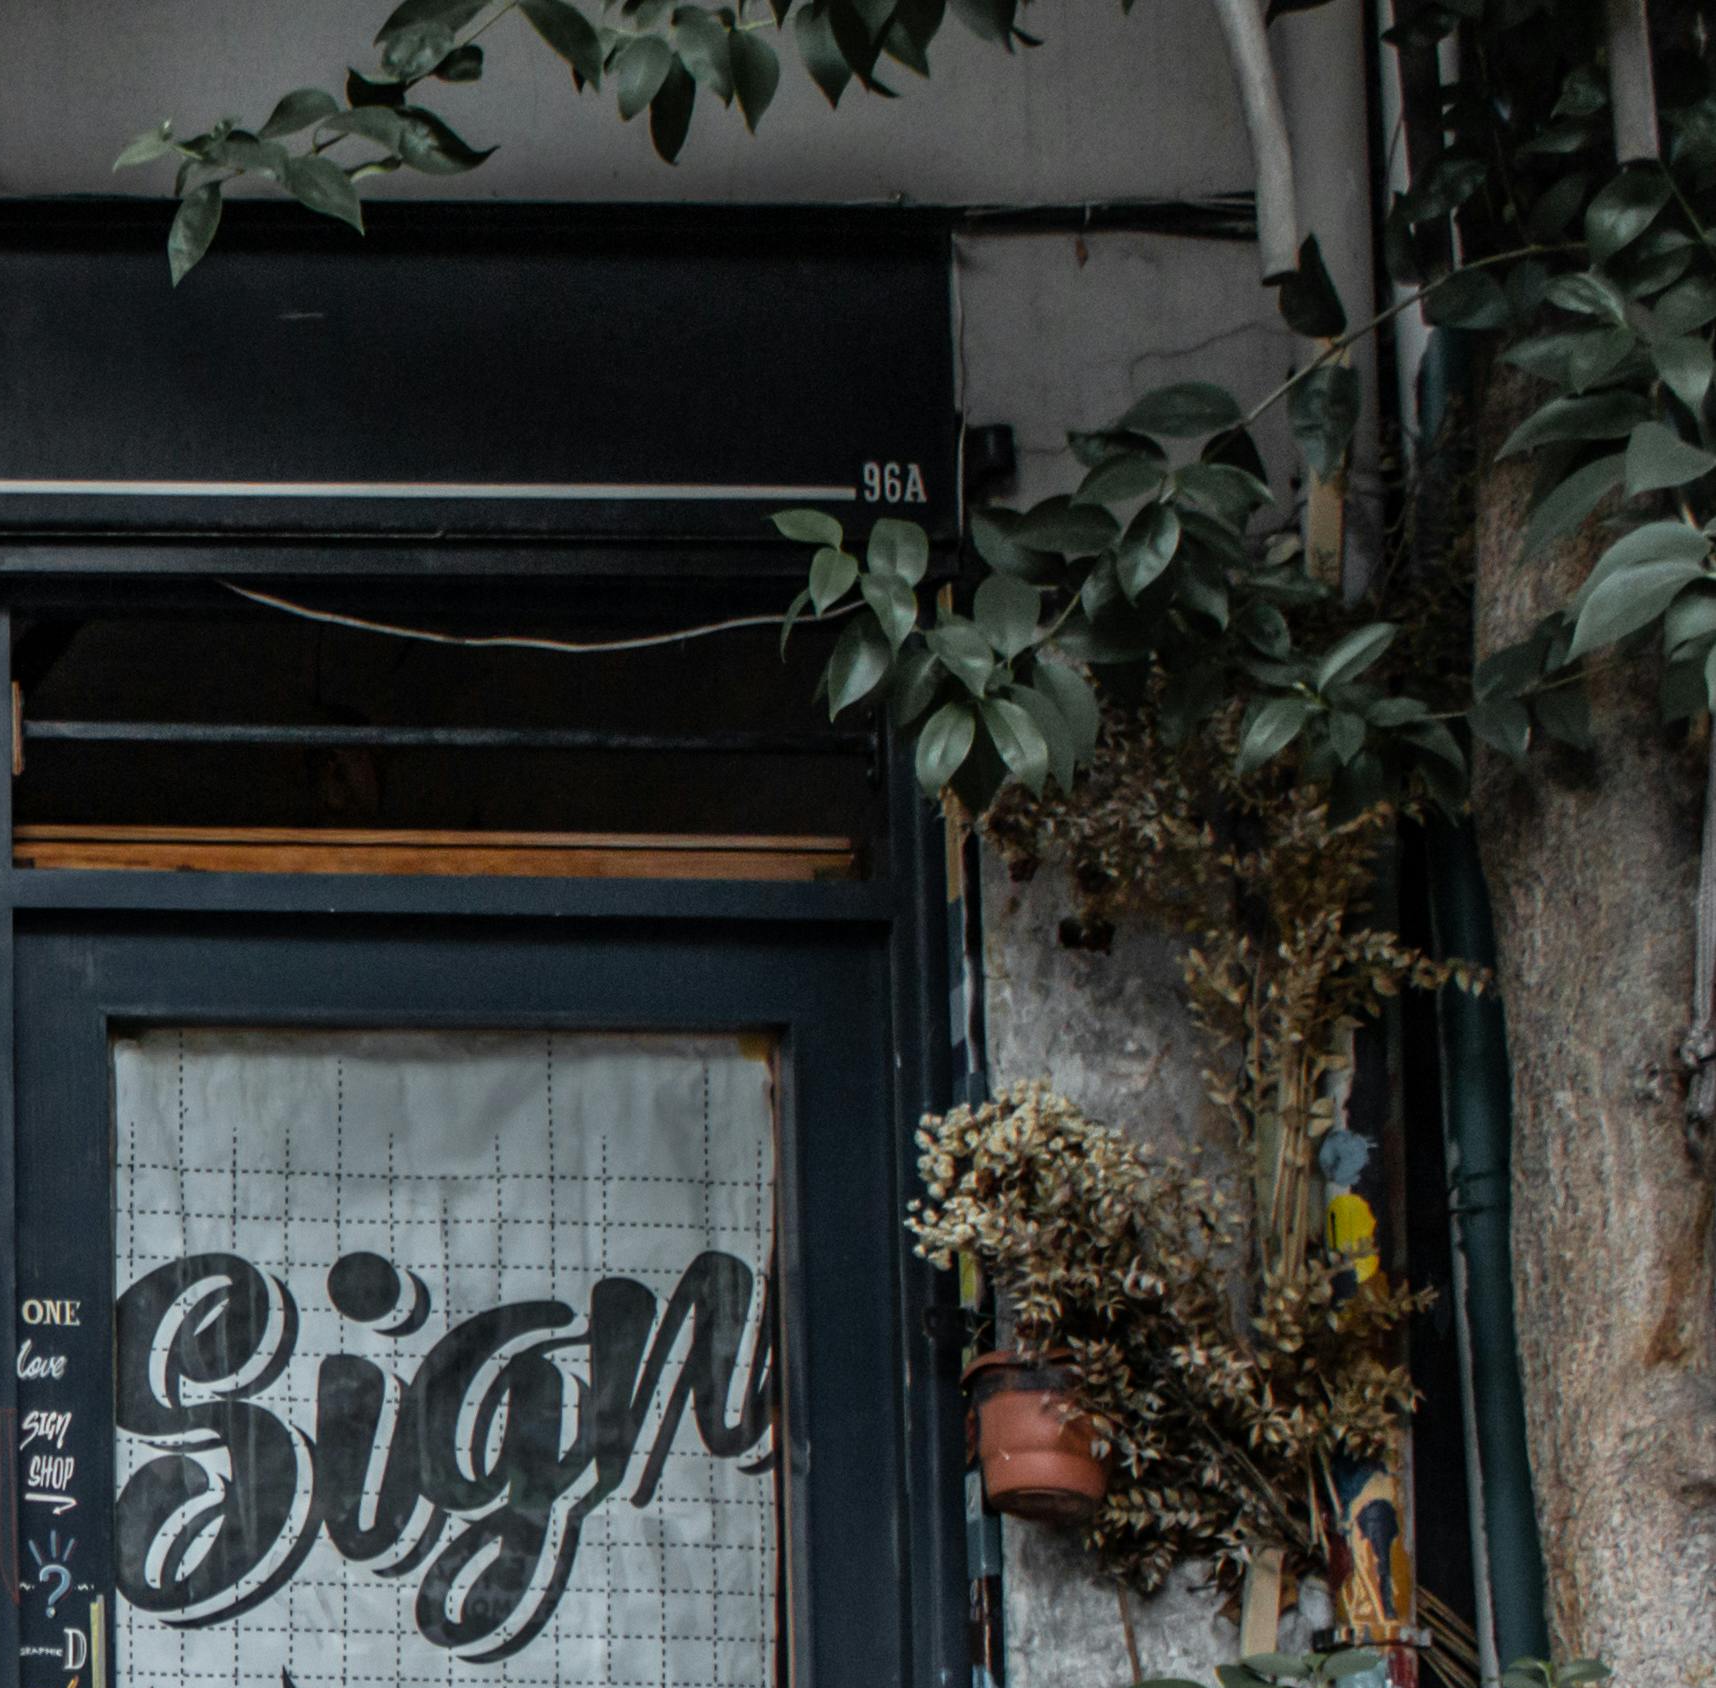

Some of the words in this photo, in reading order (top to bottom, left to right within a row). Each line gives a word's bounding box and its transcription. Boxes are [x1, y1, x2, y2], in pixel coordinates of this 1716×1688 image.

[863, 460, 928, 504] 96A
[21, 1298, 81, 1327] ONE
[28, 1455, 75, 1491] SHOP
[115, 1250, 780, 1664] Sign
